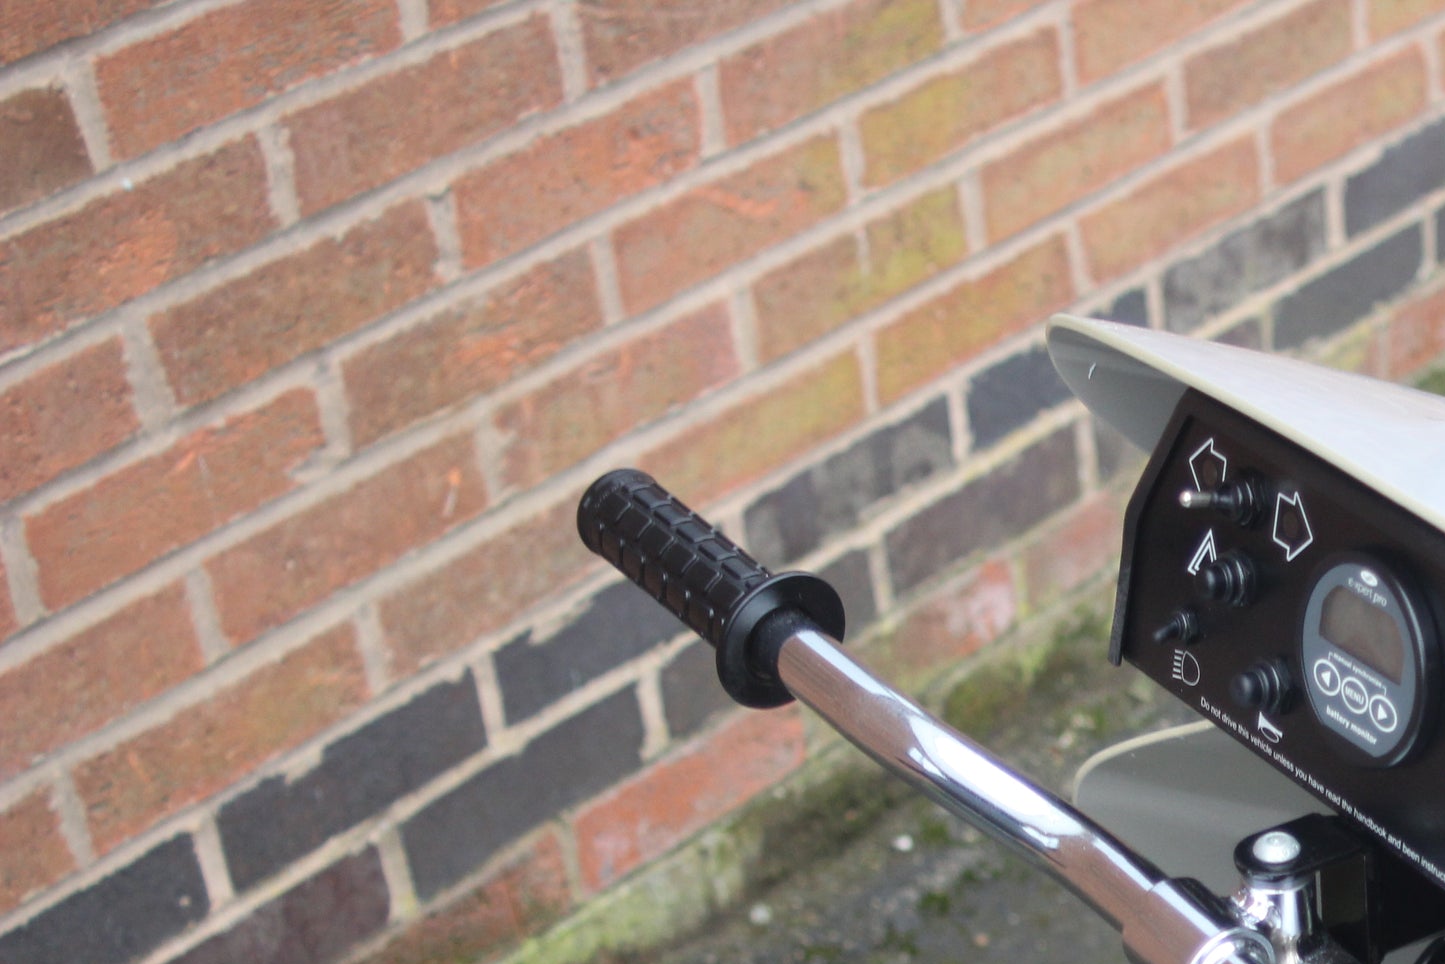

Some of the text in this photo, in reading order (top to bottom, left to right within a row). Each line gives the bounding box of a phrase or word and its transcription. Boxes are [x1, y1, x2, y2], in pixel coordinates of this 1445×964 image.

[1373, 592, 1387, 607] pro
[1345, 685, 1364, 705] MENU
[1326, 704, 1377, 744] battery monitor
[1200, 695, 1210, 711] Do
[1211, 706, 1221, 719] not
[1221, 713, 1237, 731] drive
[1238, 723, 1249, 739] this
[1250, 734, 1272, 756] vehicle
[1273, 751, 1294, 772] unless
[1294, 766, 1307, 781] you
[1308, 774, 1324, 794] have
[1325, 789, 1341, 806] read
[1341, 799, 1353, 814] the
[1353, 807, 1387, 840] handbook
[1387, 834, 1402, 850] and
[1402, 842, 1420, 864] been
